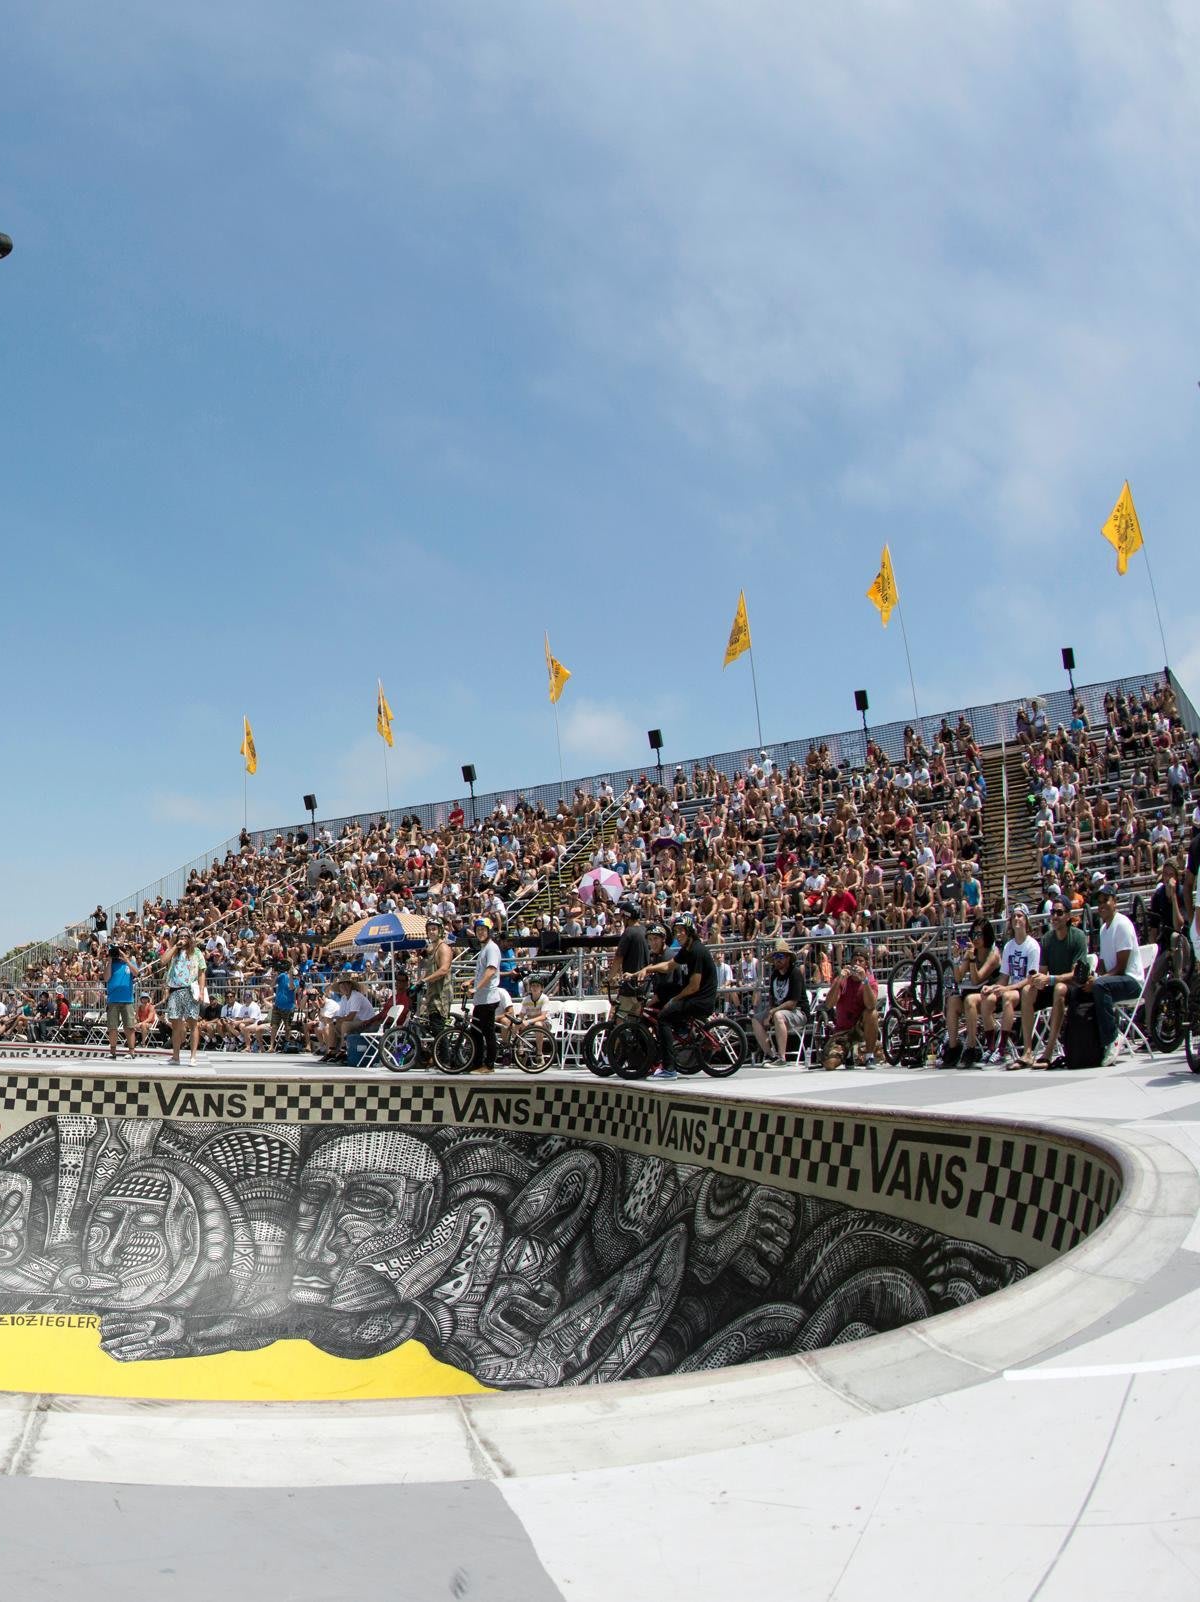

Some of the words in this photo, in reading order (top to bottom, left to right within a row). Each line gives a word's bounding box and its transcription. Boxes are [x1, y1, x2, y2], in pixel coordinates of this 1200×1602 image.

[154, 1082, 248, 1118] VANS
[448, 1087, 531, 1125] VANS
[656, 1100, 710, 1155] VANS
[870, 1126, 973, 1209] VANS
